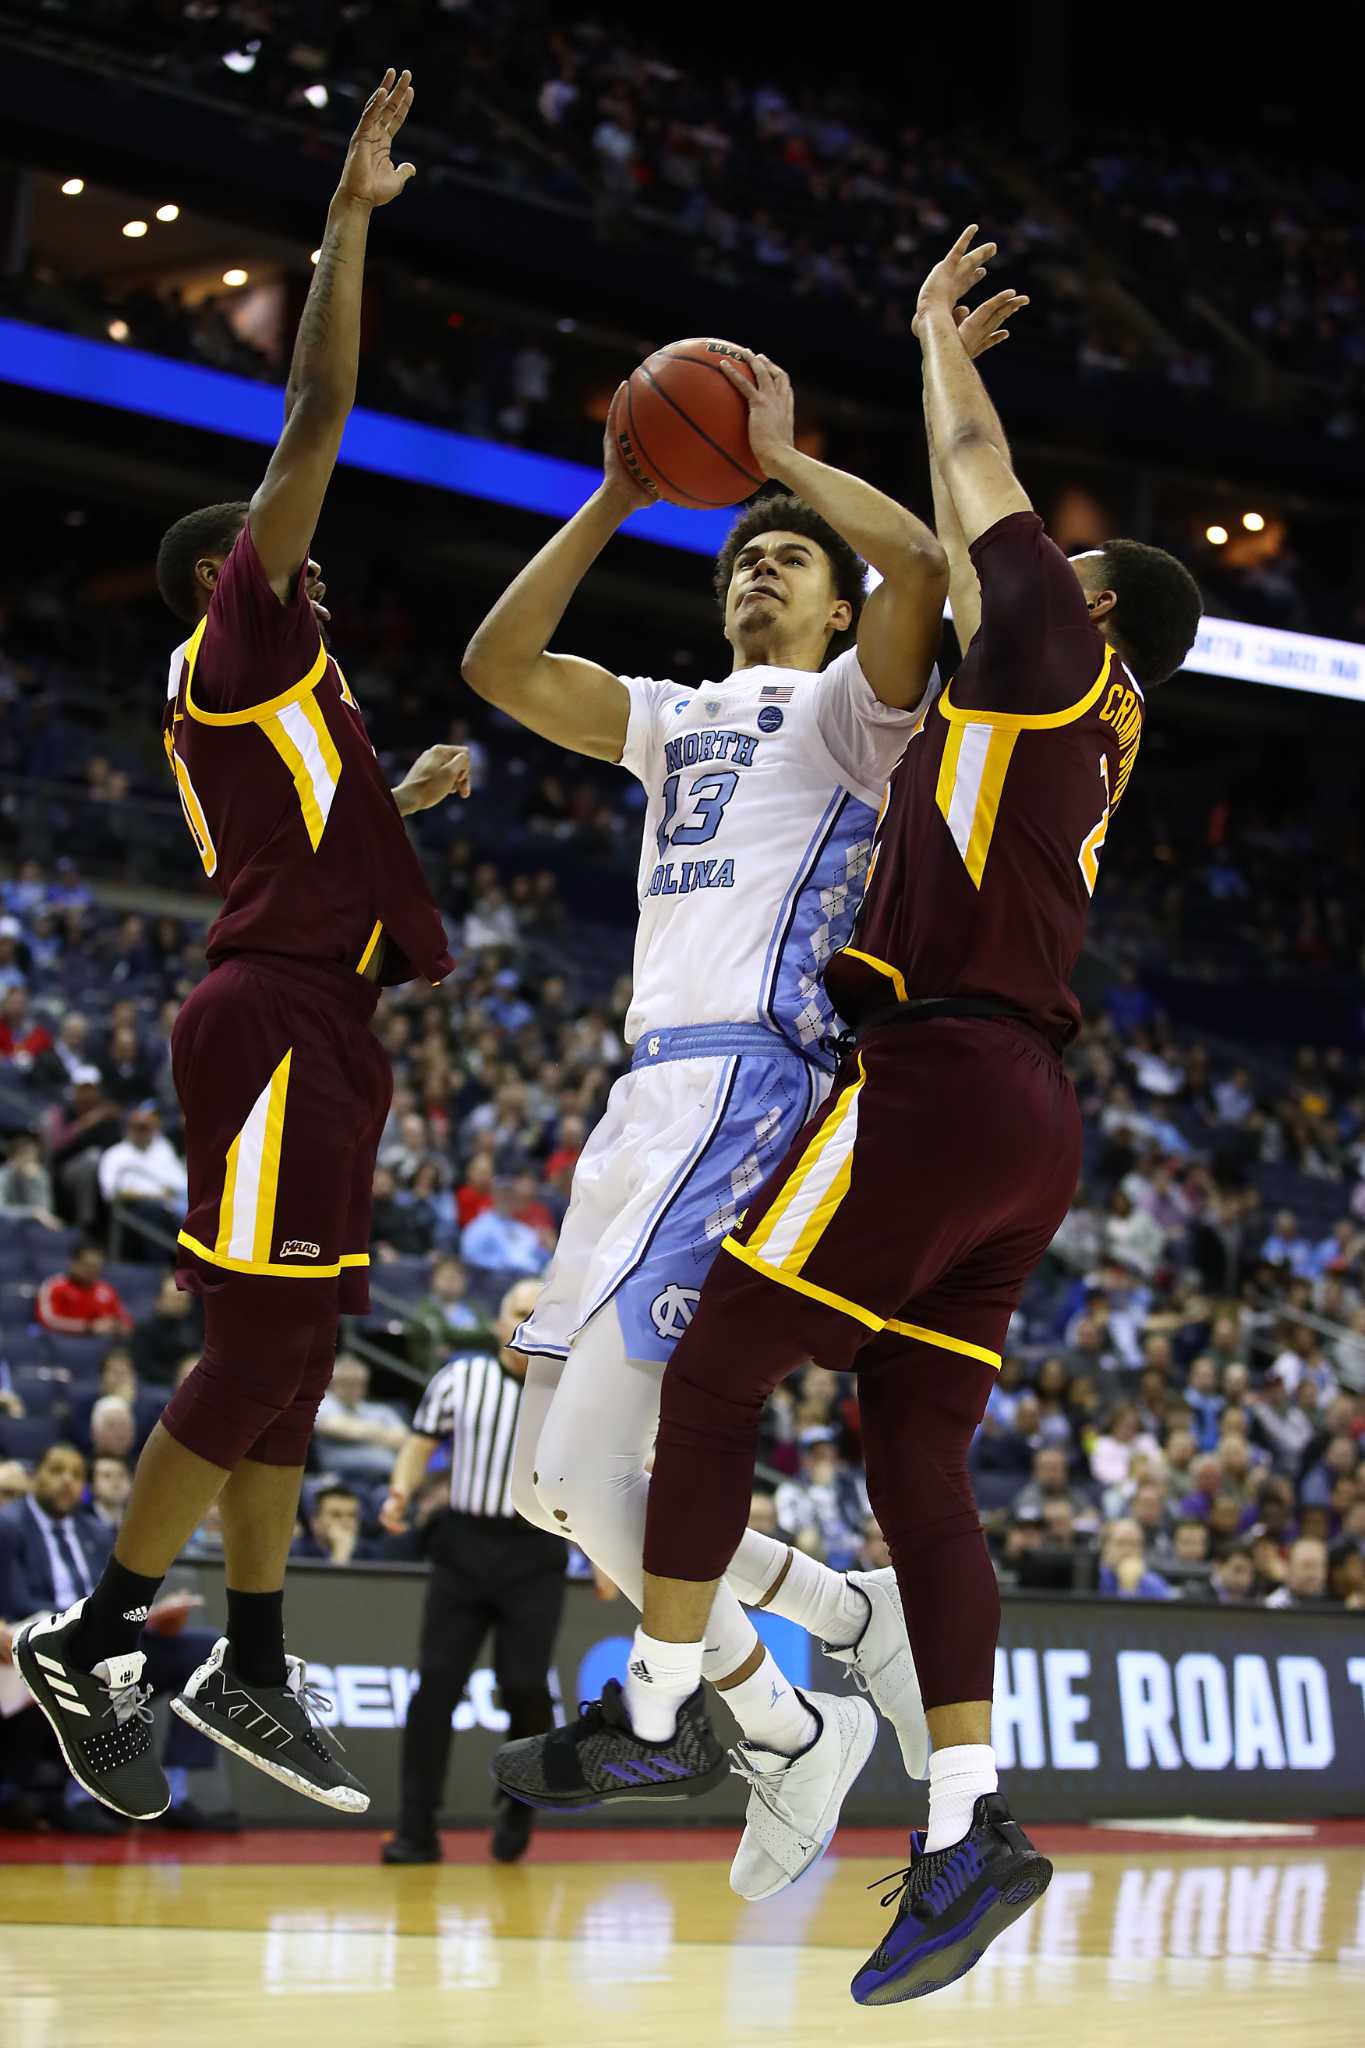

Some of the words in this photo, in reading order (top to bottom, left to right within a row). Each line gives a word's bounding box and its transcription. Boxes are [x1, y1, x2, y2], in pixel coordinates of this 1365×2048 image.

[664, 730, 759, 775] NORTH
[656, 771, 740, 860] 13
[645, 858, 735, 897] OLINA
[280, 1240, 320, 1258] MAAC
[991, 1647, 1099, 1770] HE
[1116, 1650, 1336, 1771] ROAD
